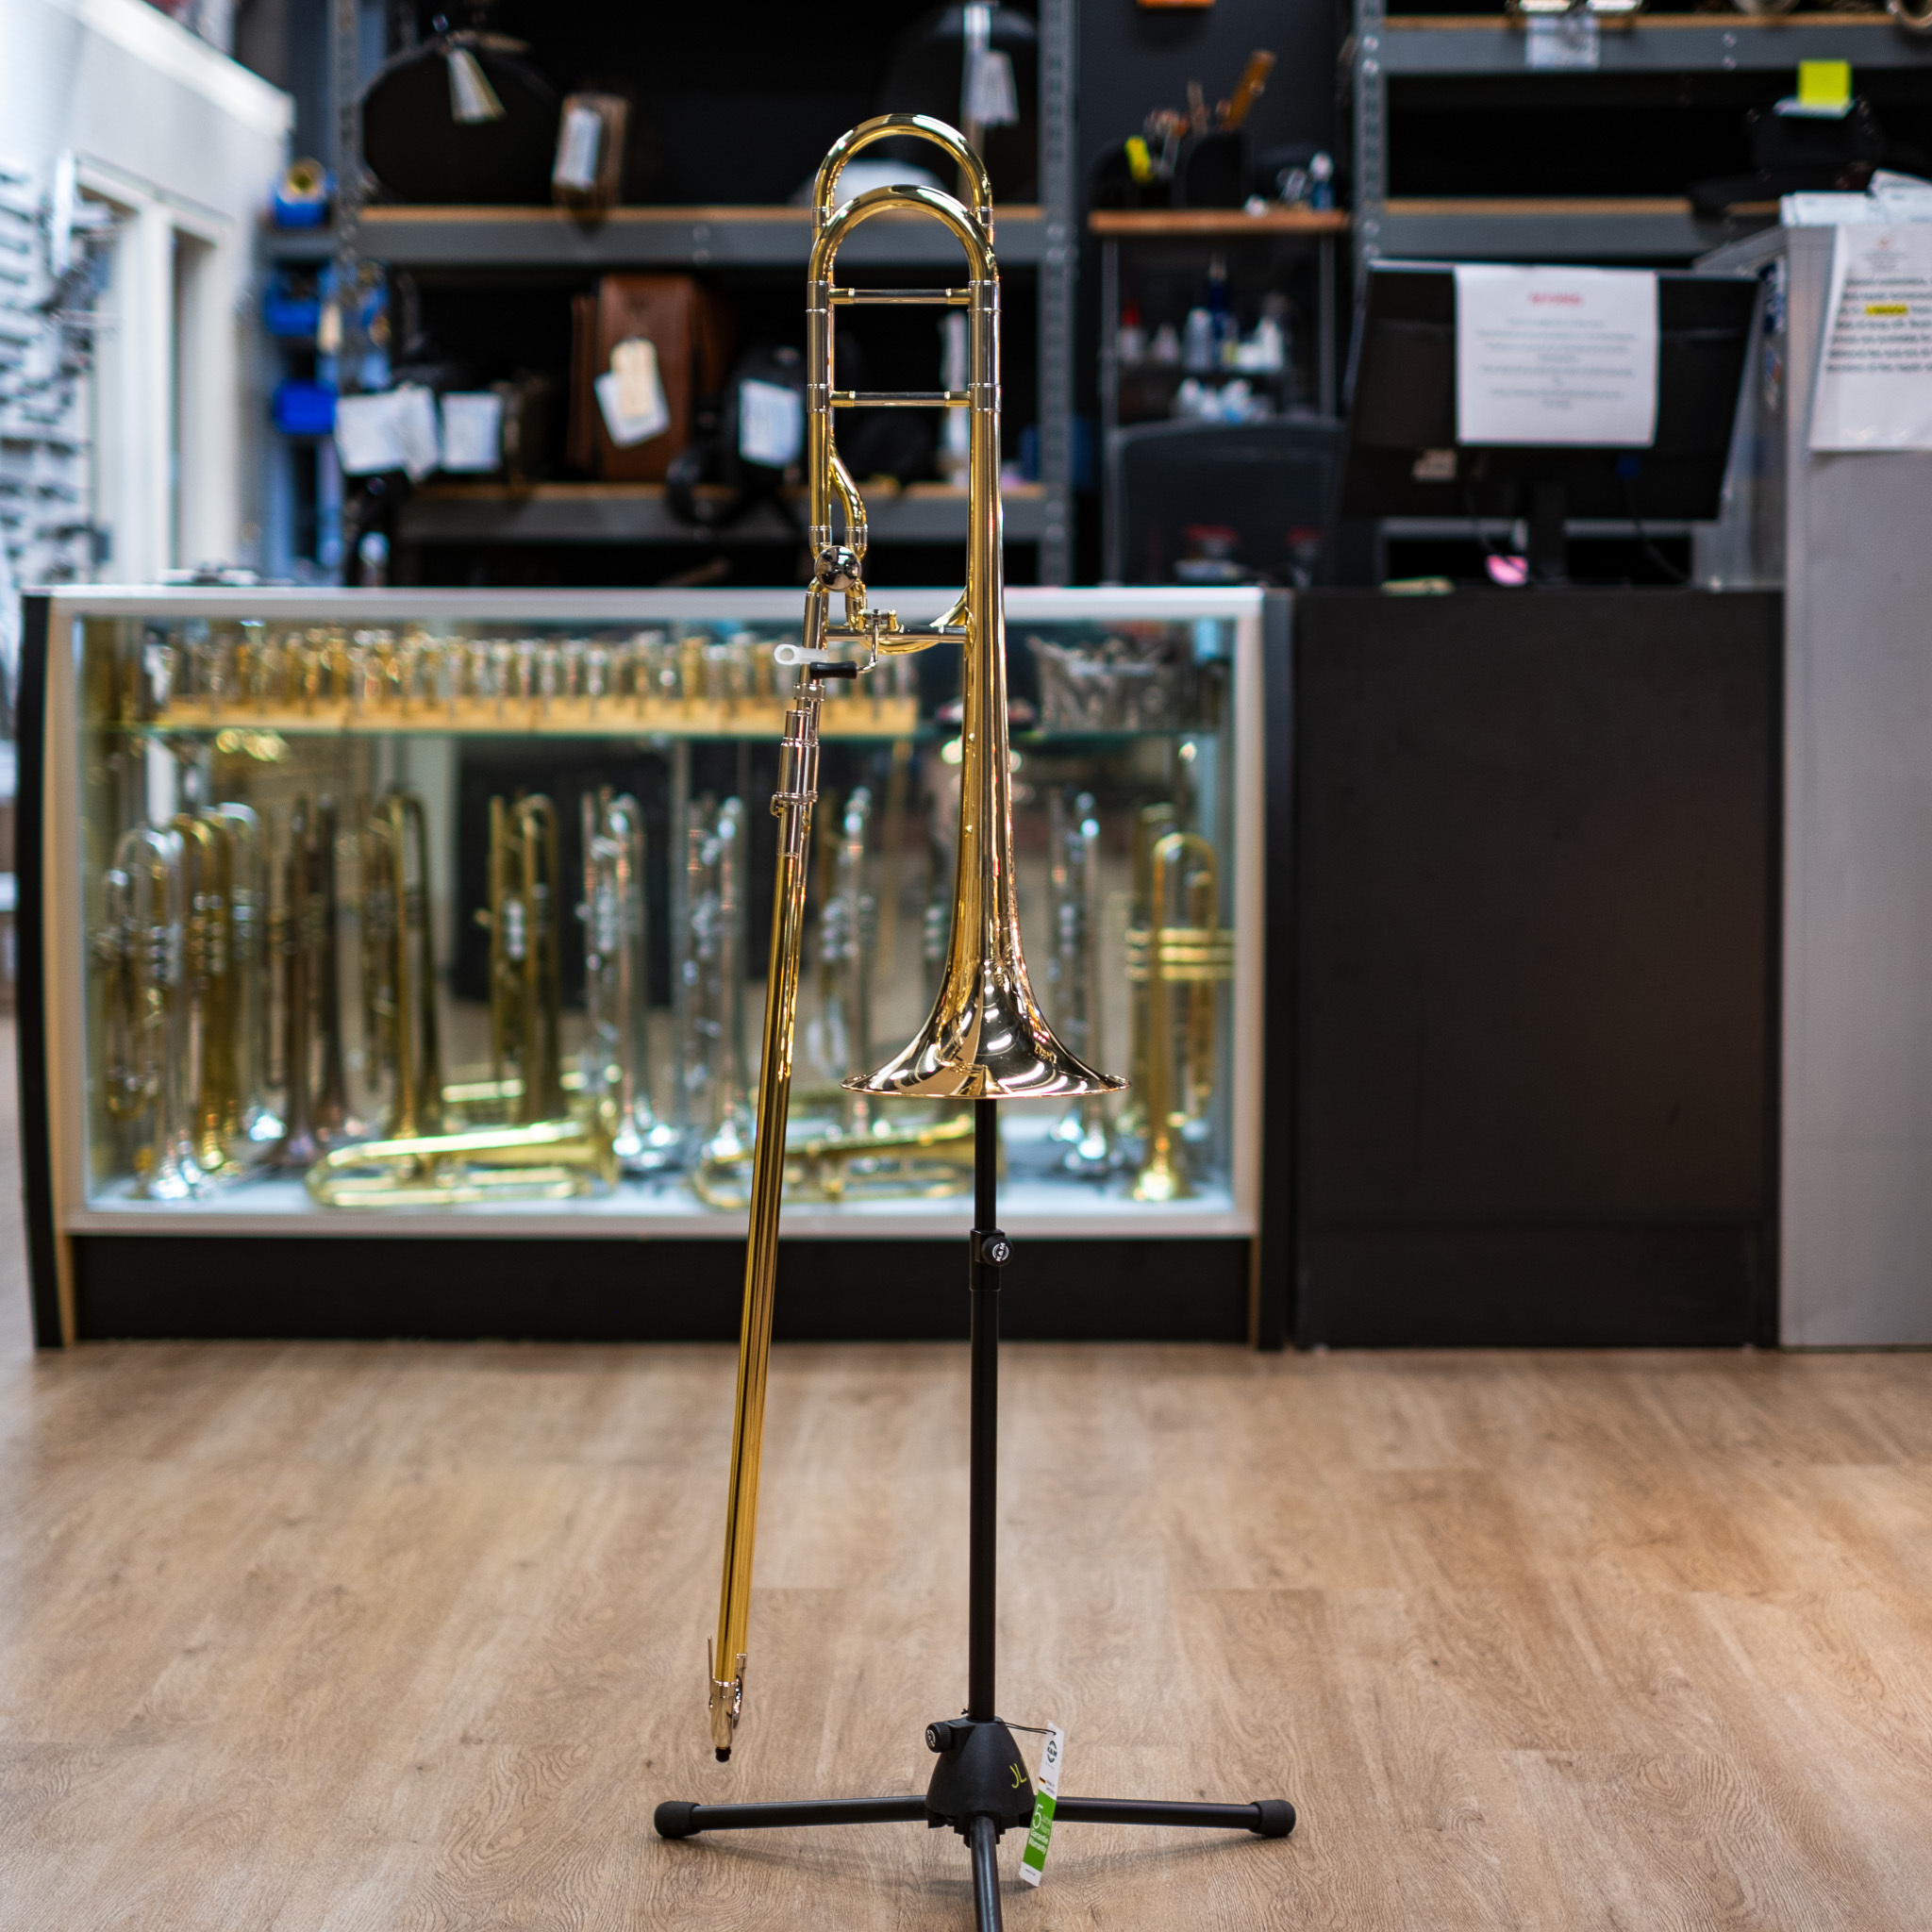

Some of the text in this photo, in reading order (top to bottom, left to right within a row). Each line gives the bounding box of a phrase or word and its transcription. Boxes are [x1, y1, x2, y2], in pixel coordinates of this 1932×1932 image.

[995, 1242, 1006, 1262] K&M
[1046, 1745, 1058, 1758] K&M
[1032, 1803, 1043, 1829] 5
